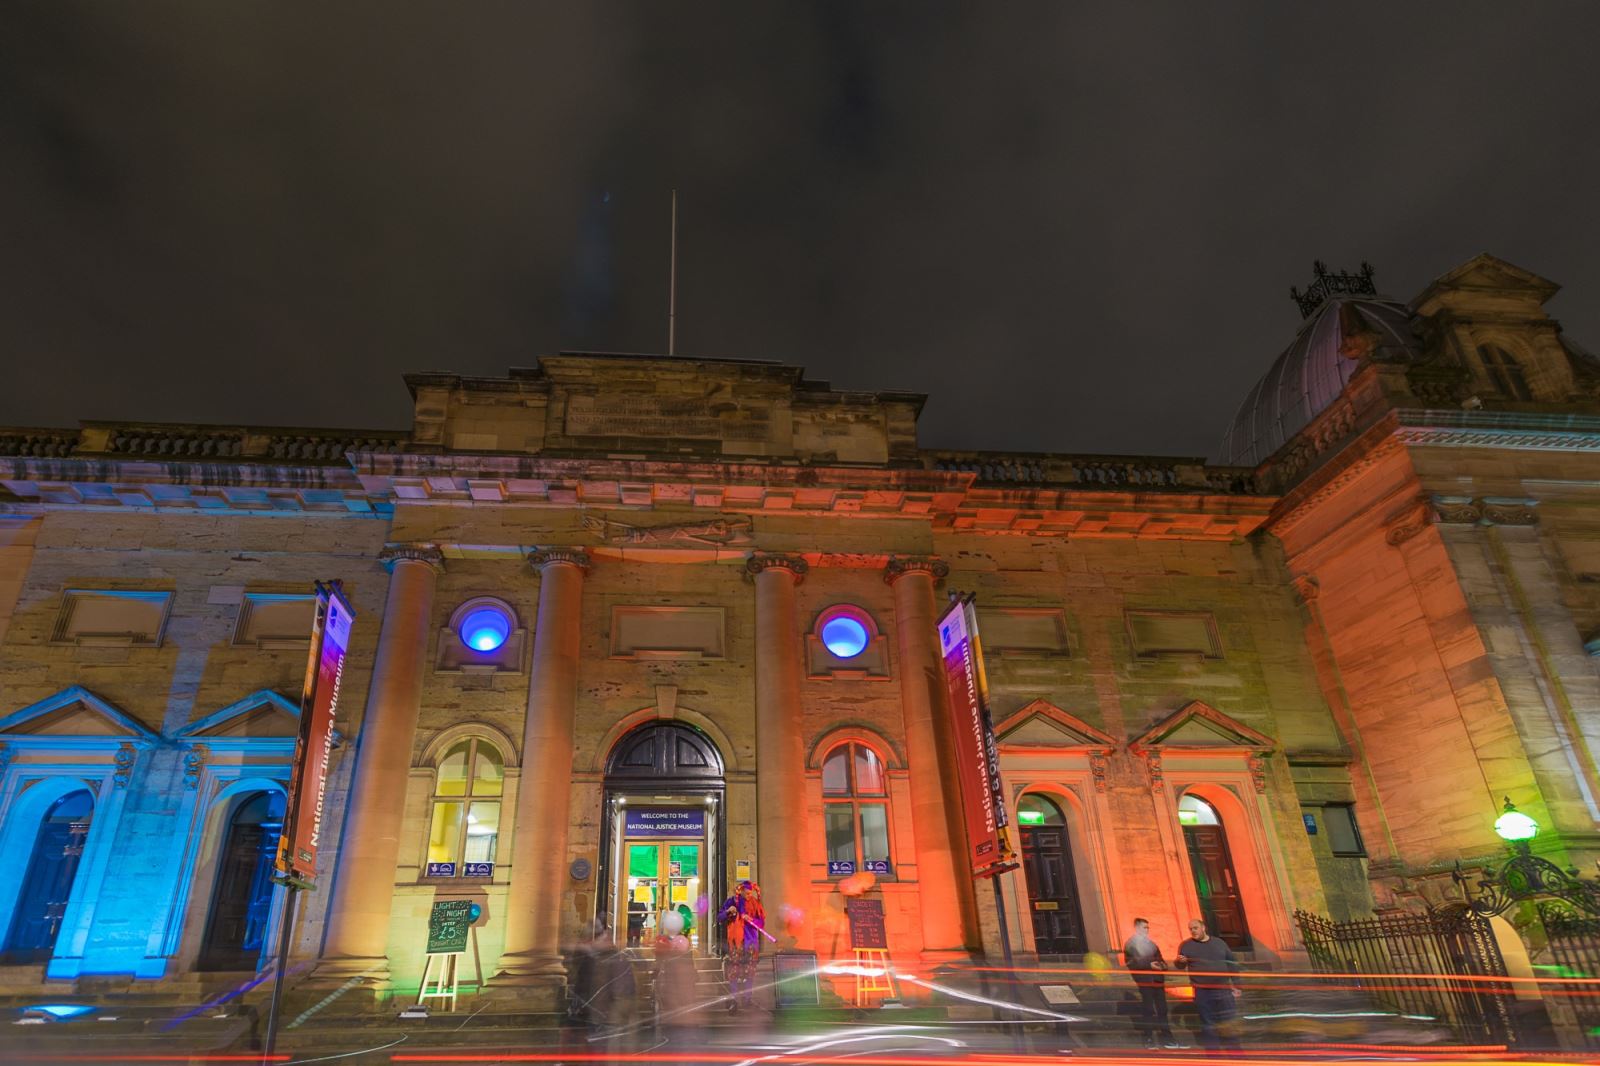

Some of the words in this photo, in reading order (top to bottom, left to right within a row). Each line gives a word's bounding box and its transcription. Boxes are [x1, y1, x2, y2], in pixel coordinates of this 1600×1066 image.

[962, 642, 976, 705] Museum
[971, 706, 983, 759] Justice
[310, 776, 326, 847] National
[321, 719, 334, 770] Justice
[328, 654, 345, 716] Museum
[977, 762, 994, 833] National
[991, 778, 1000, 792] &
[434, 901, 457, 910] LIGHT
[446, 909, 468, 917] NIGHT
[438, 926, 456, 939] £5
